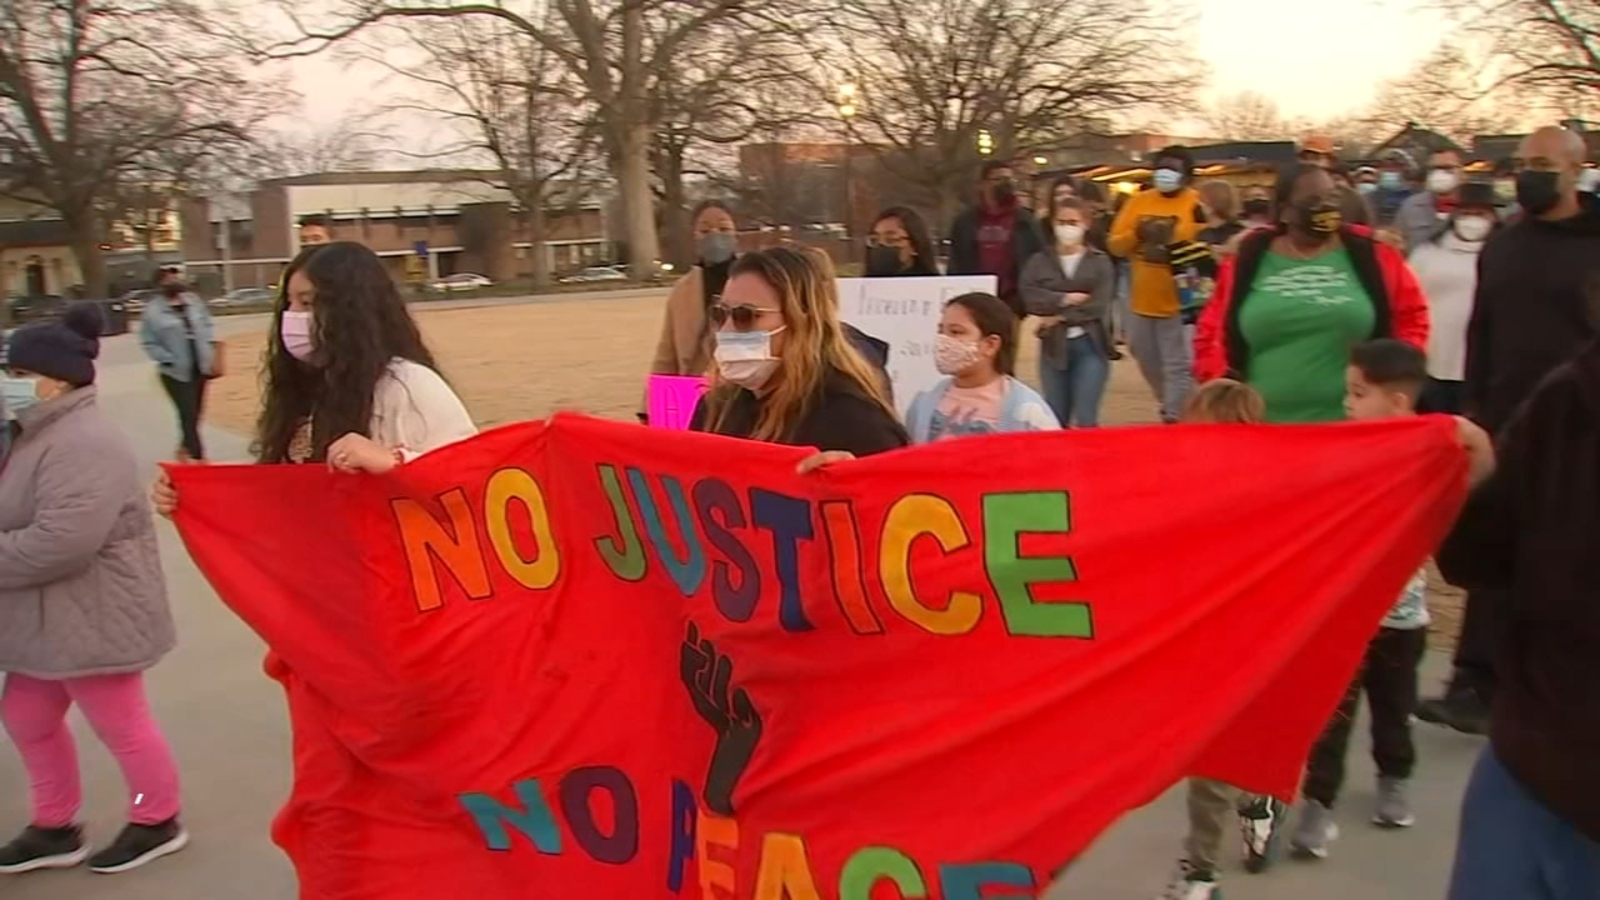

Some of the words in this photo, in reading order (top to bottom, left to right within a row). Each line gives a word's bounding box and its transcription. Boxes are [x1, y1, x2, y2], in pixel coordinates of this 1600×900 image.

[391, 467, 560, 613] NO
[594, 463, 1094, 640] JUSTICE
[455, 765, 639, 864] NO
